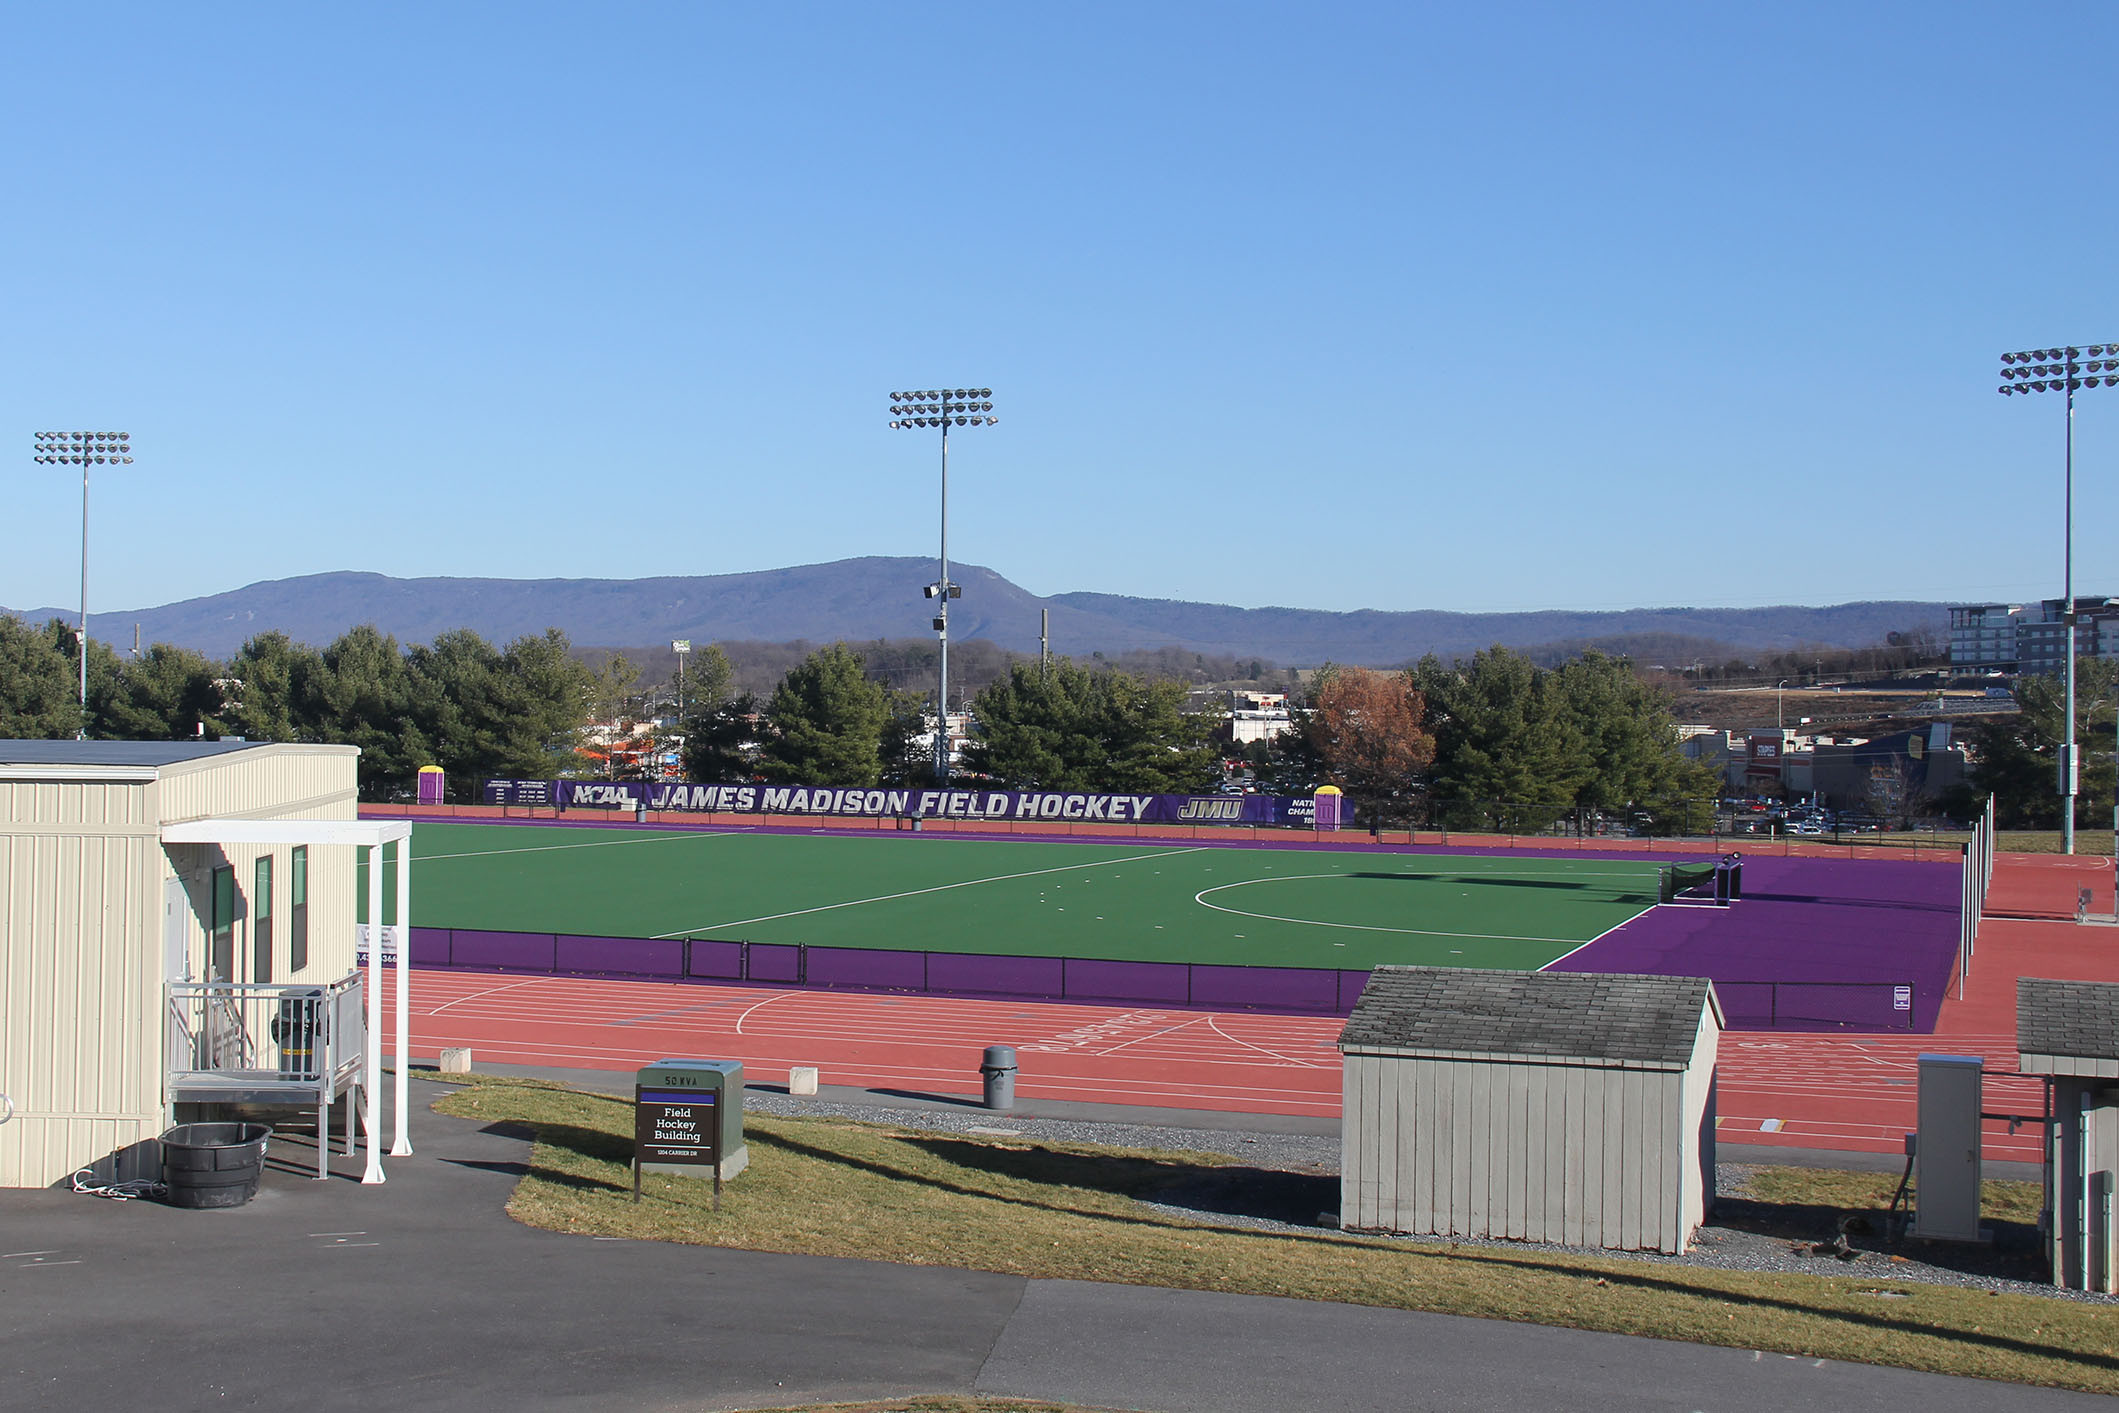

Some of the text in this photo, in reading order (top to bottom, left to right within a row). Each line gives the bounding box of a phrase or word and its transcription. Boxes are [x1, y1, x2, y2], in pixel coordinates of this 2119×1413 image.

[573, 785, 632, 805] NCAA
[651, 785, 1153, 820] JAMES MADISON FIELD HOCKEY
[1178, 798, 1243, 820] JMU
[1291, 799, 1315, 807] NATI
[665, 1076, 697, 1086] 50 KVA
[664, 1107, 691, 1118] Field
[656, 1119, 696, 1132] Hockey
[654, 1130, 701, 1144] Building
